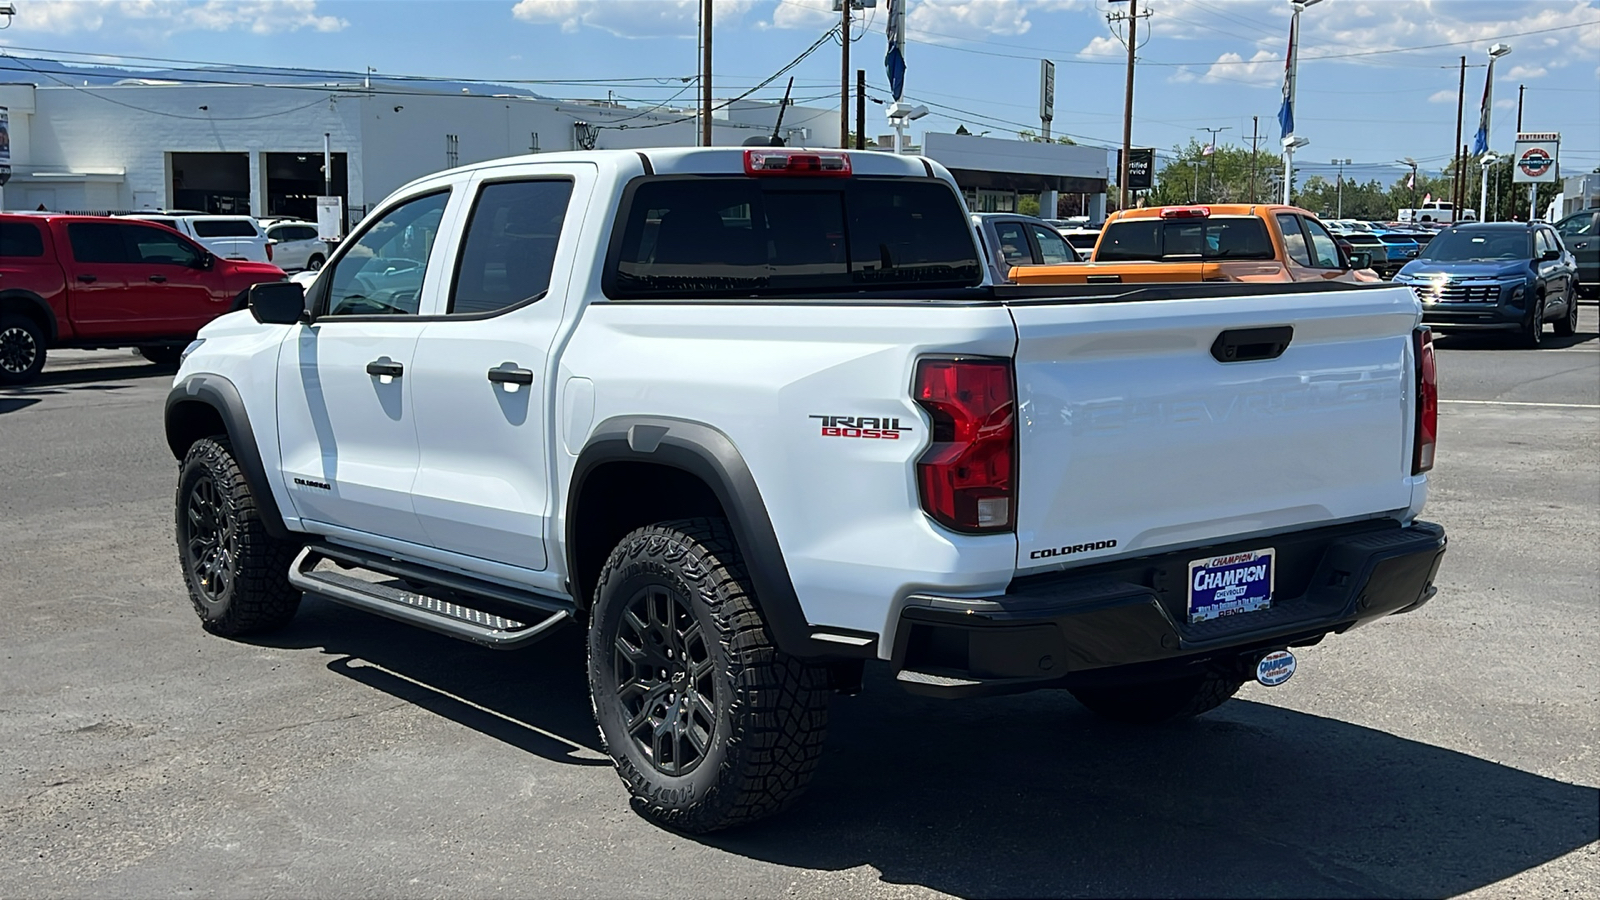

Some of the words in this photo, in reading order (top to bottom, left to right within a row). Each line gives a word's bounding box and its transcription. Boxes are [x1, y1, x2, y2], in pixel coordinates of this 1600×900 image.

[809, 414, 912, 431] TRAIL
[822, 427, 899, 440] BOSS
[1030, 539, 1117, 559] COLORADO
[1212, 553, 1253, 567] CHAMPION
[1194, 565, 1266, 591] CHAMPION
[1217, 587, 1245, 598] CHEVROLET
[620, 753, 696, 805] GOODYEAR
